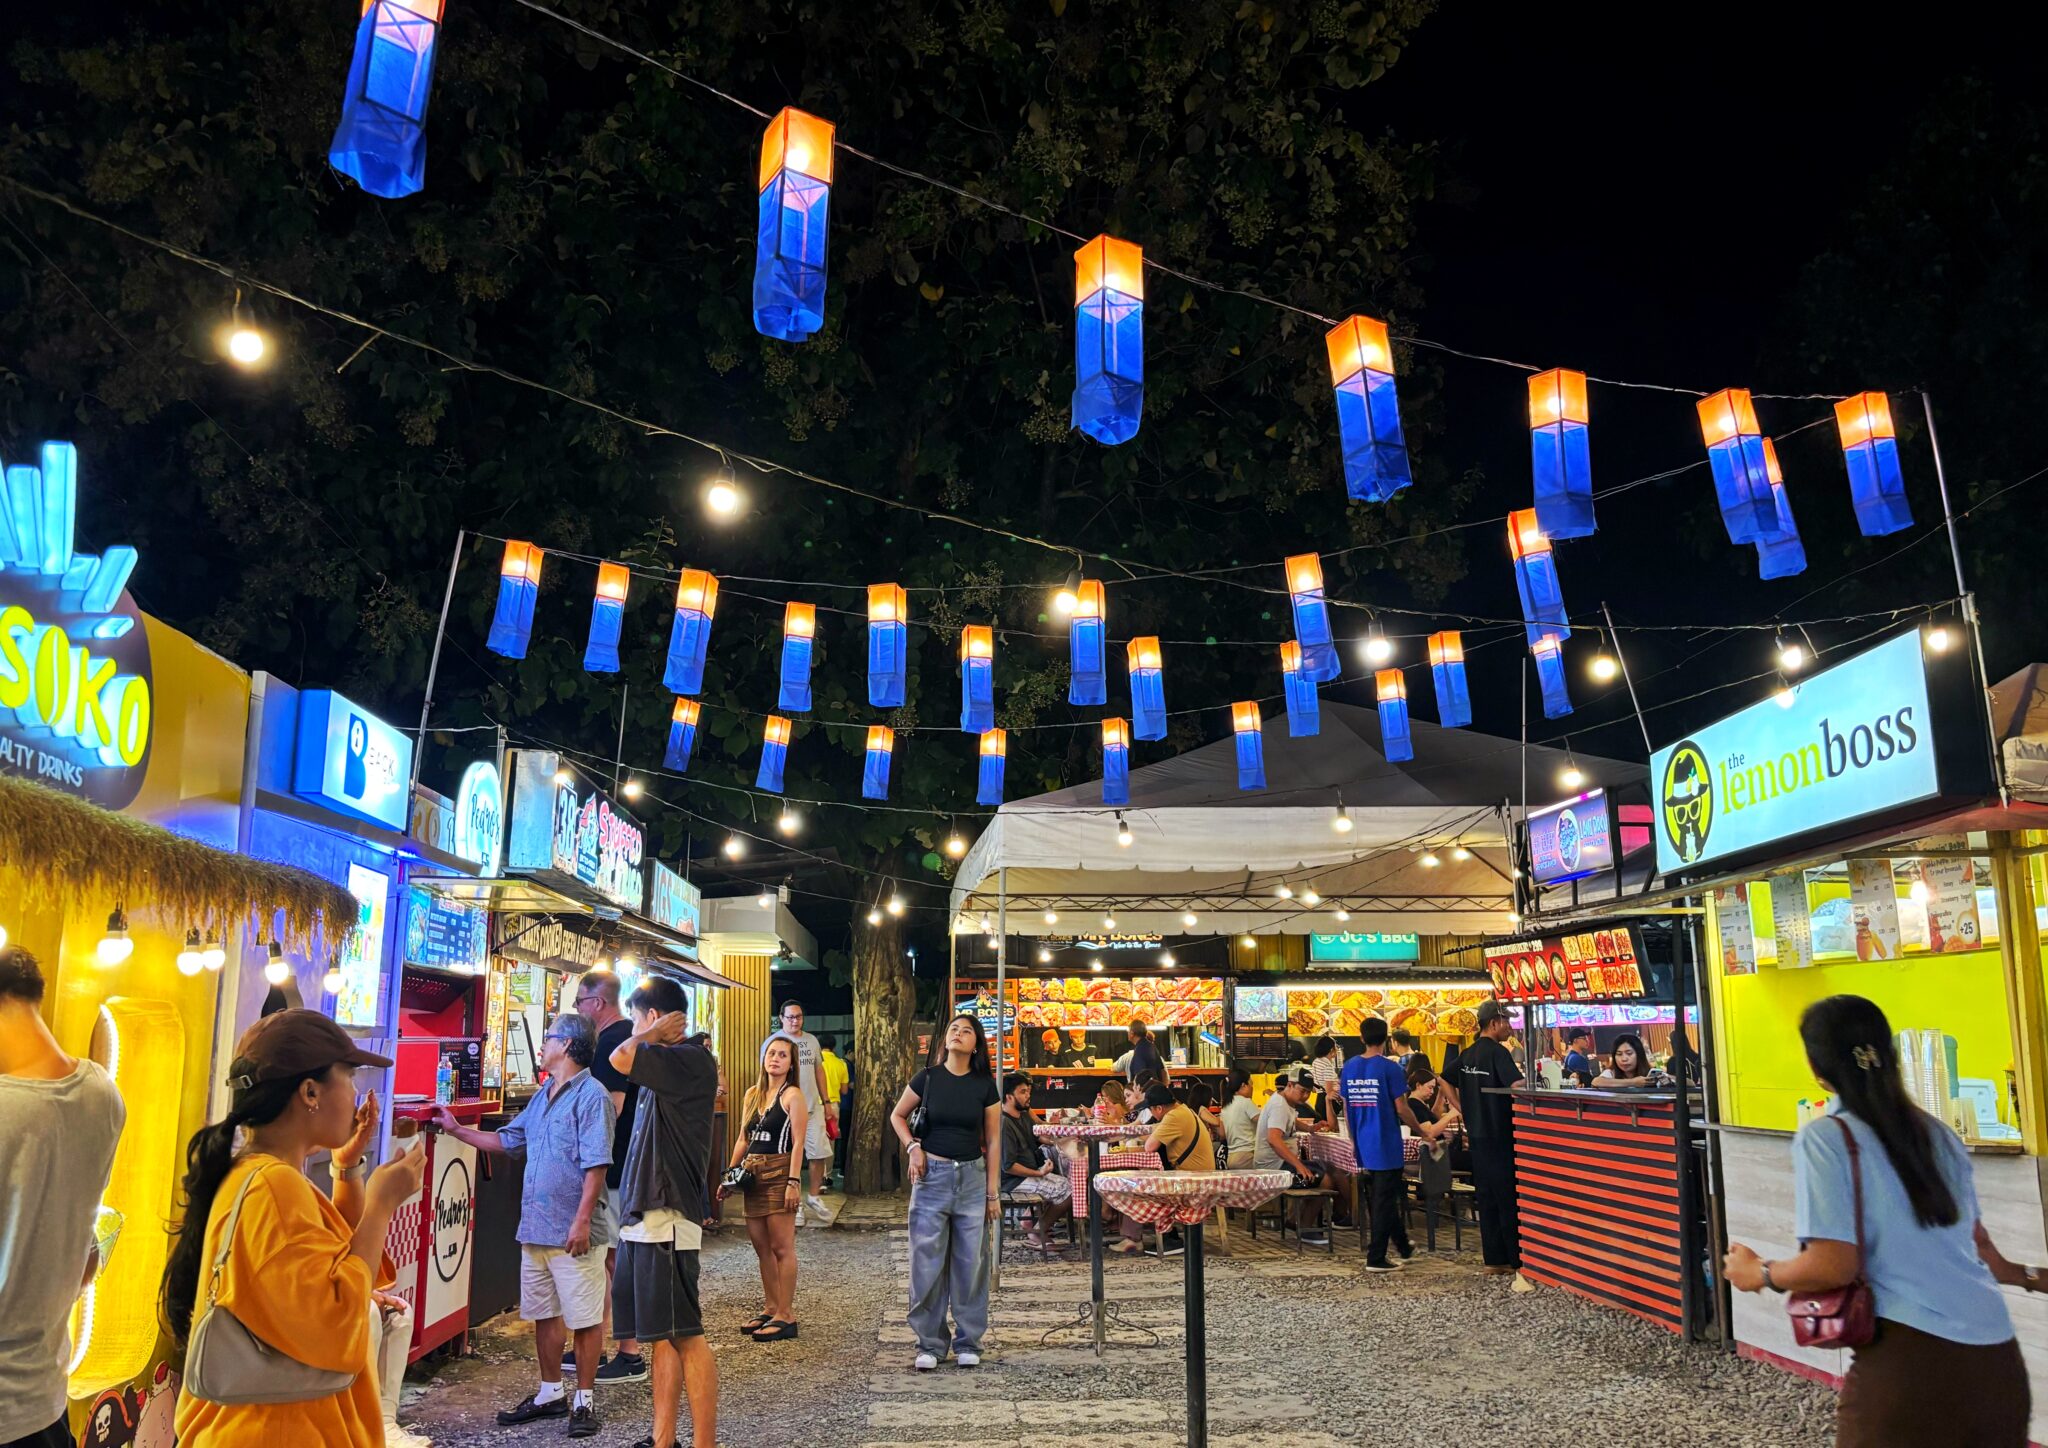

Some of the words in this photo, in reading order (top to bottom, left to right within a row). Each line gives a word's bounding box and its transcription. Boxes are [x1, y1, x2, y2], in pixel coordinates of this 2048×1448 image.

[0, 605, 150, 767] SOKO
[38, 752, 84, 787] DRINKS
[1718, 707, 1917, 815] lemonboss
[1728, 752, 1745, 770] the
[471, 793, 499, 846] Pedro's
[518, 914, 541, 953] ALWAYS
[540, 923, 562, 961] COOKED
[561, 930, 577, 962] FRESH
[1960, 921, 1974, 934] +25
[438, 1192, 467, 1232] Pedro's
